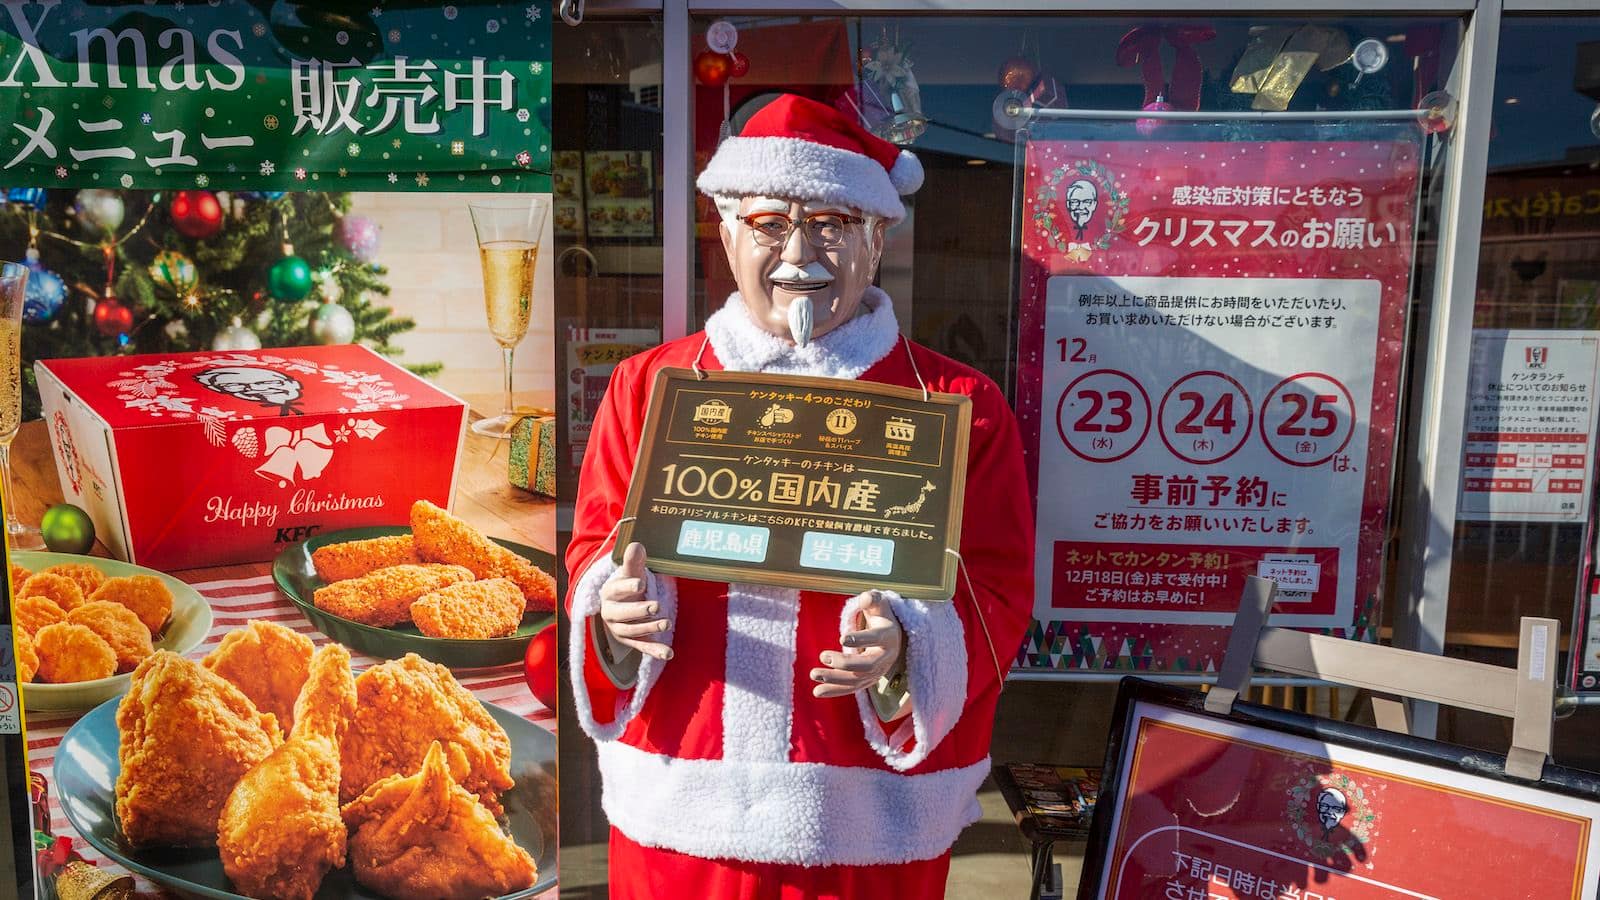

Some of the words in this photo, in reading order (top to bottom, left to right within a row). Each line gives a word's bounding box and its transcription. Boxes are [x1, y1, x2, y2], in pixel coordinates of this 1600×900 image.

[0, 0, 245, 90] Xmas
[290, 55, 514, 136] 販売中
[3, 107, 254, 169] メニュー
[1171, 186, 1364, 207] 感染症対策にともなう
[1132, 217, 1397, 250] クリスマスのお願い
[1078, 294, 1347, 311] 例年以上に商品提供にお時間をいただいたり、
[1085, 312, 1337, 329] お買い求めいただけない場合がございます。
[1056, 338, 1097, 363] 12月
[749, 390, 872, 409] ケンタッキー4つのこだわり
[1073, 390, 1132, 433] 23
[835, 415, 847, 428] 11
[1174, 391, 1236, 435] 24
[1276, 393, 1338, 438] 25
[743, 454, 855, 473] ケンタッキーのチキンは
[662, 463, 881, 513] 100%国内産
[1130, 474, 1287, 507] 事前予約に
[204, 496, 280, 527] Happy
[287, 489, 385, 515] Christmas
[273, 525, 321, 543] KFC
[1094, 513, 1314, 536] ご協力をお願いいたします。
[682, 528, 764, 555] 鹿児島県
[811, 540, 883, 566] 岩手県
[1066, 549, 1229, 569] ネットでカンタン予約!
[1065, 570, 1227, 588] 12月18日(金)まで受付中!
[1084, 588, 1205, 605] ご予約はお早めに!
